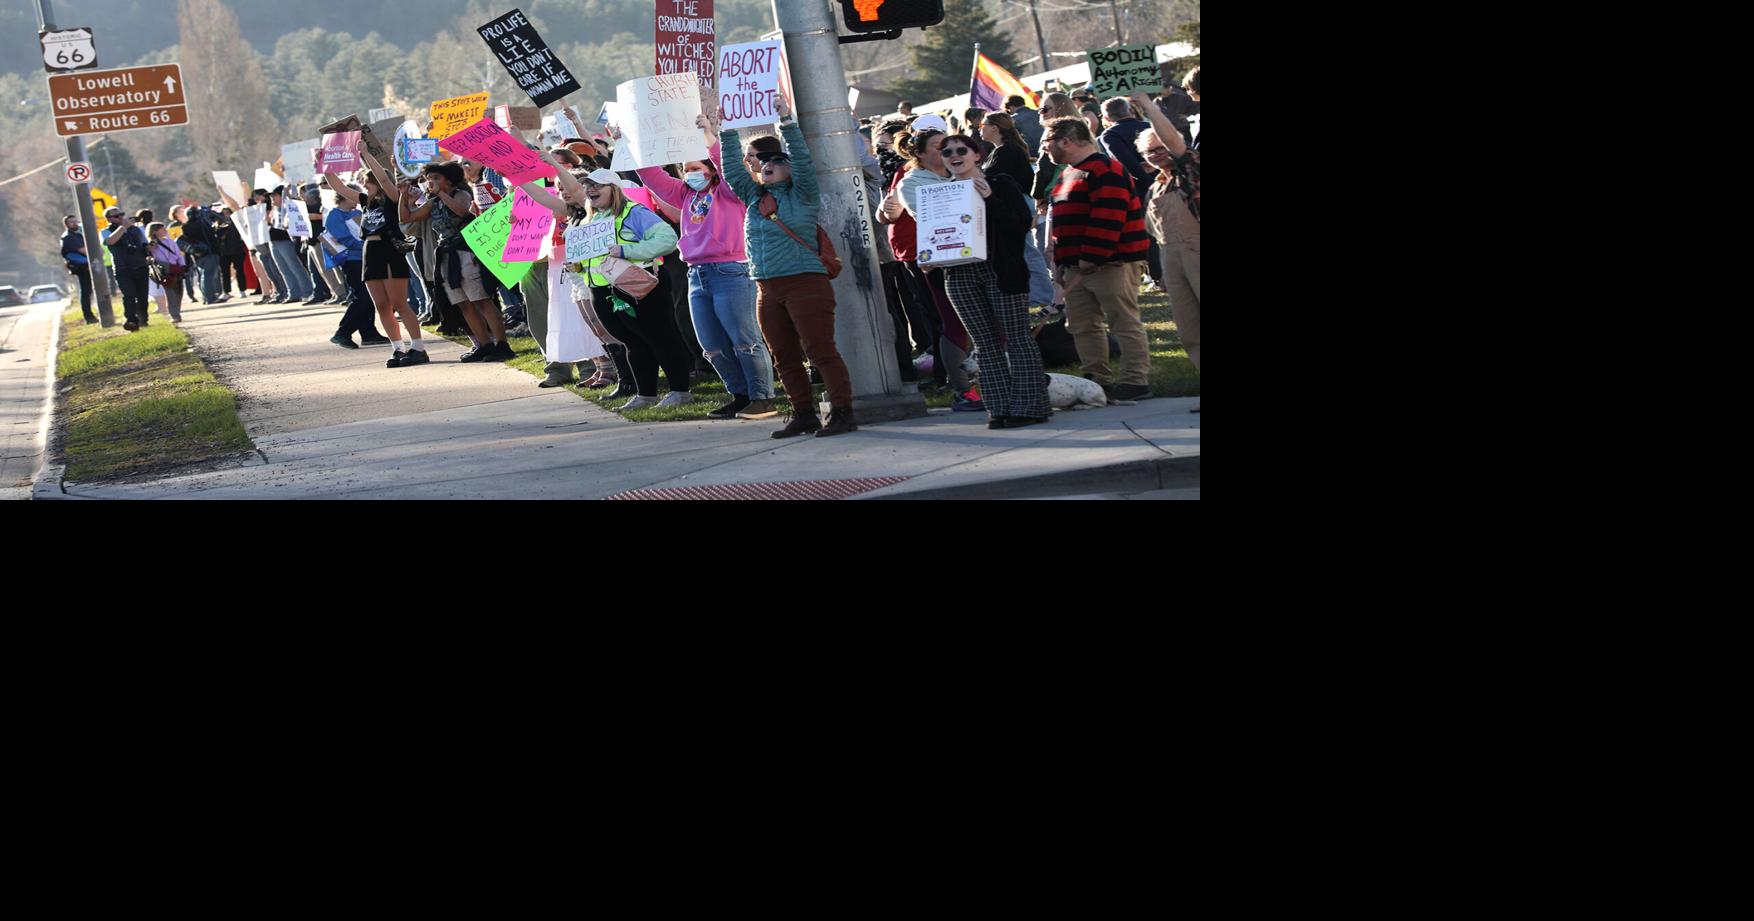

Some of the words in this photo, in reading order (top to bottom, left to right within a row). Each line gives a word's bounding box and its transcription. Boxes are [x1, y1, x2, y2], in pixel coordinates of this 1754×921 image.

[672, 0, 698, 15] THE
[481, 25, 503, 41] PRO
[501, 12, 527, 32] LIFE
[500, 37, 512, 47] IS
[513, 34, 523, 42] A
[677, 34, 690, 44] OF
[56, 48, 84, 64] 66
[499, 39, 536, 63] LIE
[658, 42, 714, 60] WITCHES
[1091, 44, 1155, 65] BODILY
[508, 61, 529, 77] YOU
[658, 57, 678, 75] YOU
[720, 47, 777, 78] ABORT
[77, 73, 135, 91] Lowell
[518, 70, 542, 87] CARE
[541, 62, 554, 77] IF
[551, 69, 571, 87] DIE
[1095, 65, 1160, 81] Autonomy
[736, 77, 758, 91] the
[1116, 78, 1131, 91] A
[57, 90, 161, 110] Observatory
[648, 86, 695, 106] STATE
[722, 89, 776, 121] COURT
[433, 101, 450, 110] THIS
[89, 114, 139, 129] Route
[150, 110, 171, 123] 66
[433, 112, 444, 120] WE
[324, 152, 341, 160] Health
[488, 140, 513, 157] AND
[513, 218, 532, 231] MY
[568, 221, 614, 243] ABORTION
[567, 240, 590, 260] SAVES
[592, 232, 615, 252] LIVES
